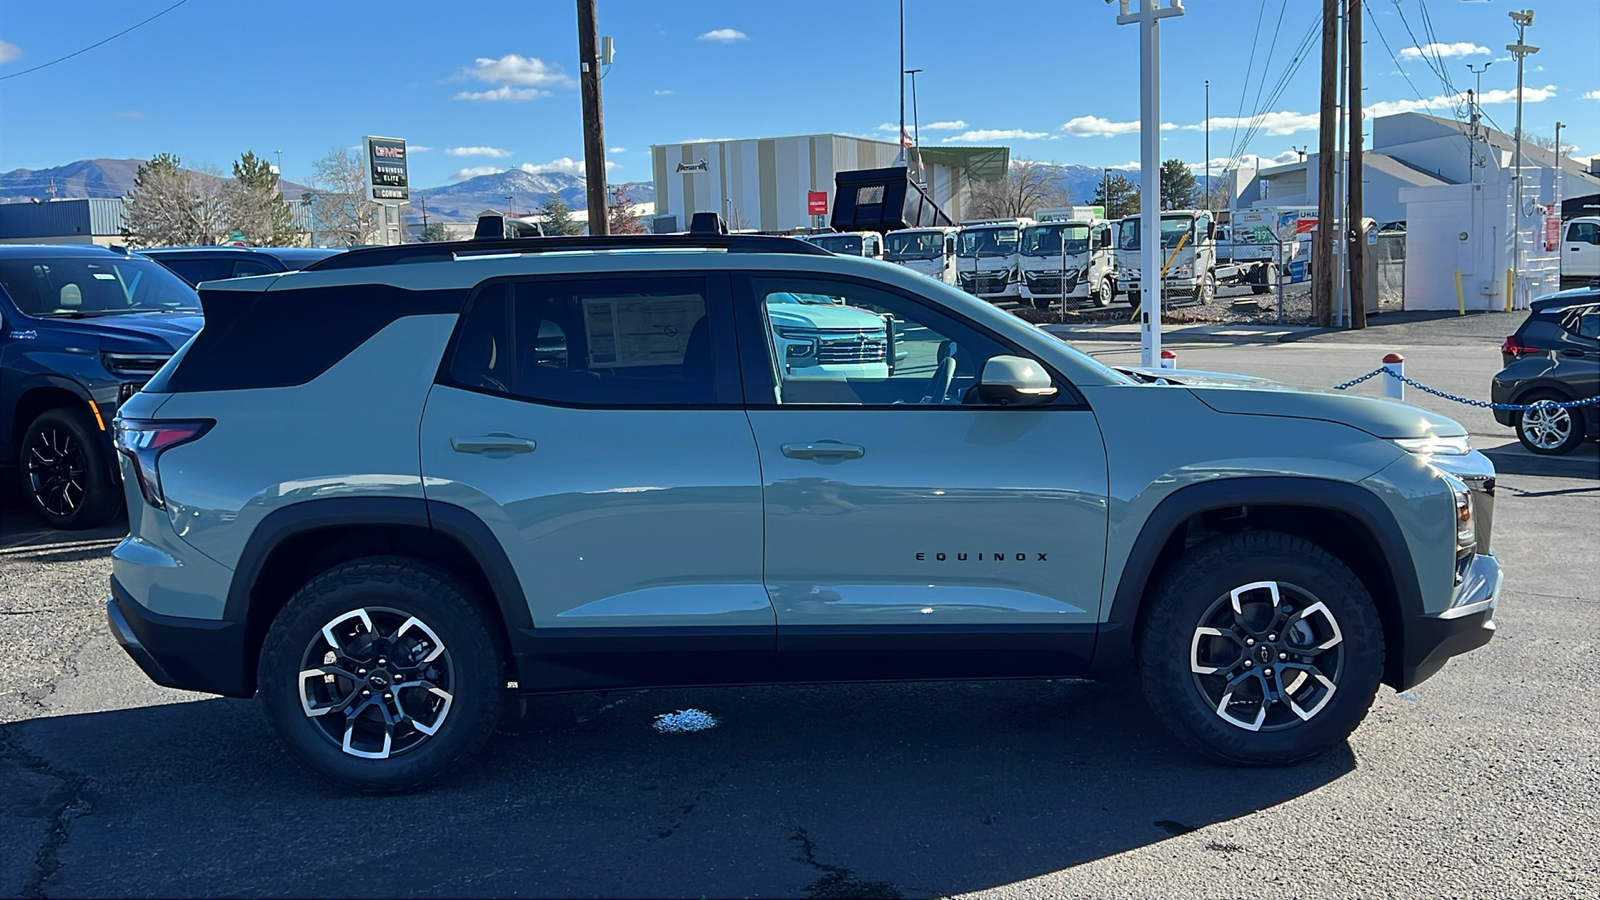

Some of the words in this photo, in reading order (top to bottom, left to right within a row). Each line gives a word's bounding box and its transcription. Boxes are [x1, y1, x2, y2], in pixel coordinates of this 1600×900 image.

[375, 146, 404, 158] GMC
[377, 166, 404, 174] BUSINESS
[915, 552, 1048, 562] EQUINOX
